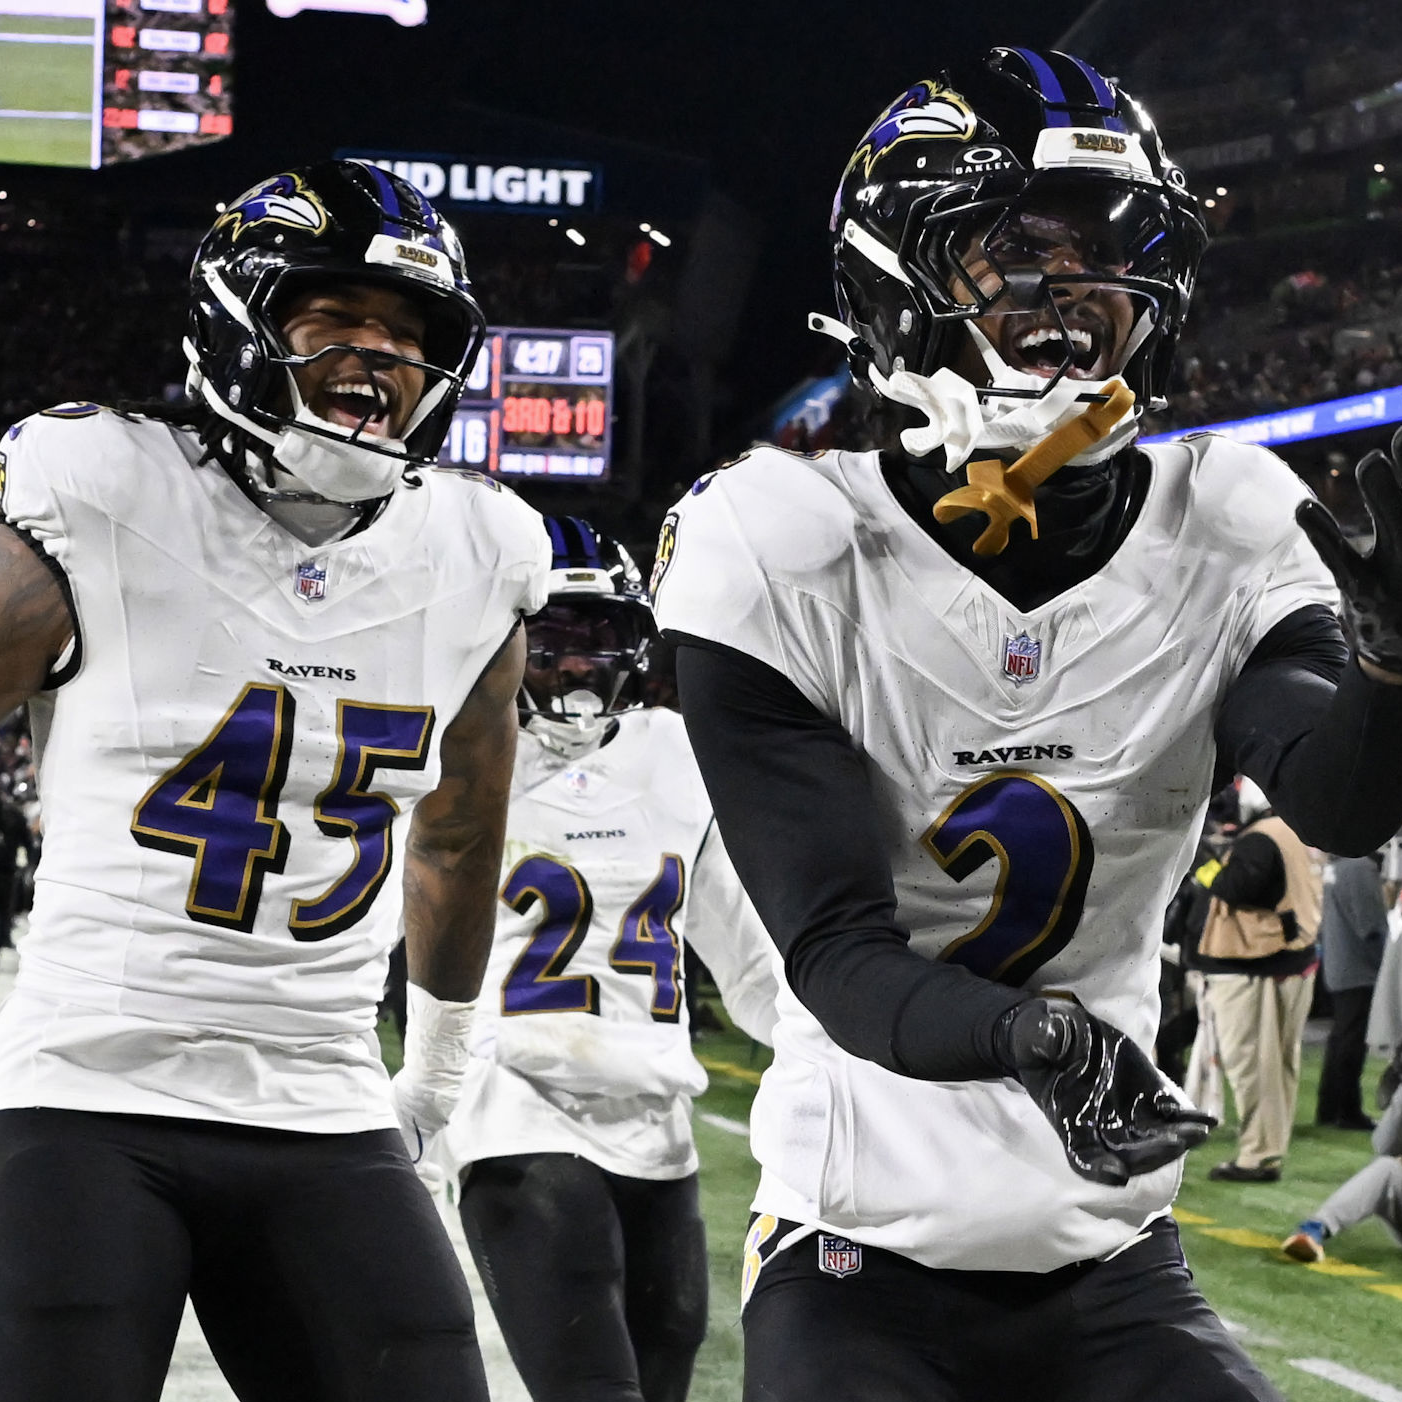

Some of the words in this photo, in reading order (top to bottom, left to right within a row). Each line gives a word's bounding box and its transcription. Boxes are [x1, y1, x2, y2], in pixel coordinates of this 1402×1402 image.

[1071, 132, 1128, 154] RAVENS
[955, 160, 1012, 175] OAKLEY
[450, 163, 593, 206] LIGHT
[395, 244, 439, 268] RAVENS
[502, 396, 551, 433] 3RD
[575, 400, 606, 436] 10
[449, 418, 487, 463] 16
[300, 578, 322, 596] NFL
[265, 658, 357, 681] RAVENS
[1007, 652, 1034, 677] NFL
[952, 744, 1074, 766] RAVENS
[129, 680, 436, 942] 45
[564, 829, 626, 841] RAVENS
[919, 768, 1096, 1003] 2
[499, 851, 686, 1024] 24
[827, 1251, 856, 1270] NFL
